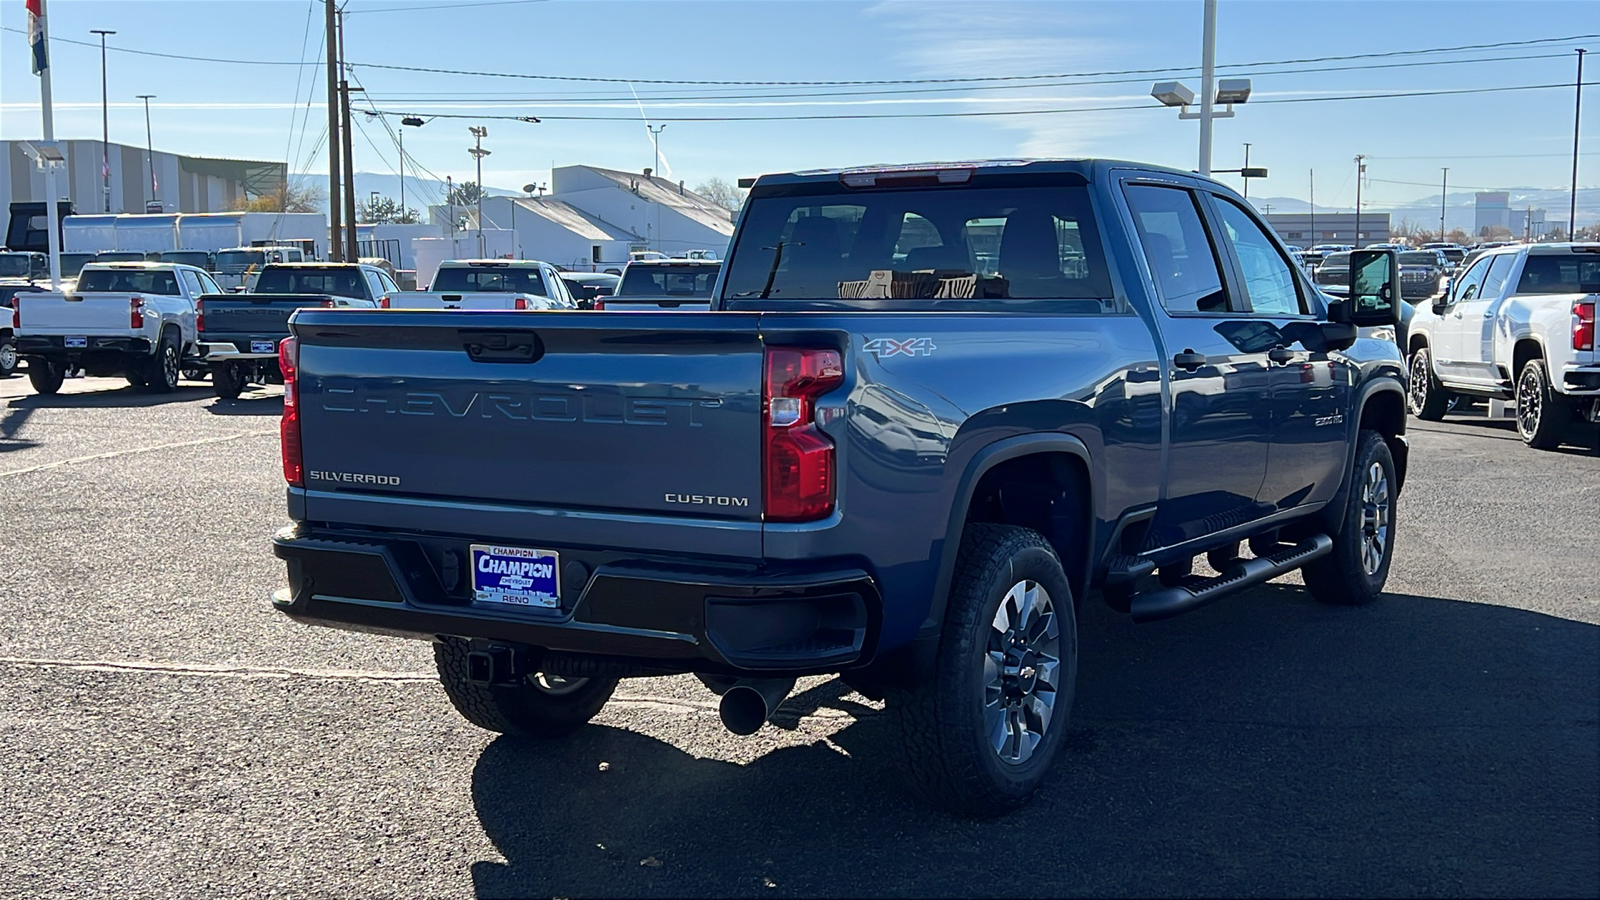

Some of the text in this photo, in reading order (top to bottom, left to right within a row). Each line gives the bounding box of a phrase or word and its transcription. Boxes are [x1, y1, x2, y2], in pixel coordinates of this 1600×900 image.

[321, 387, 724, 427] CHEVROLET
[309, 470, 401, 486] SILVERADO
[664, 493, 749, 507] CUSTOM
[493, 547, 534, 557] CHAMPION
[502, 595, 530, 604] RENO
